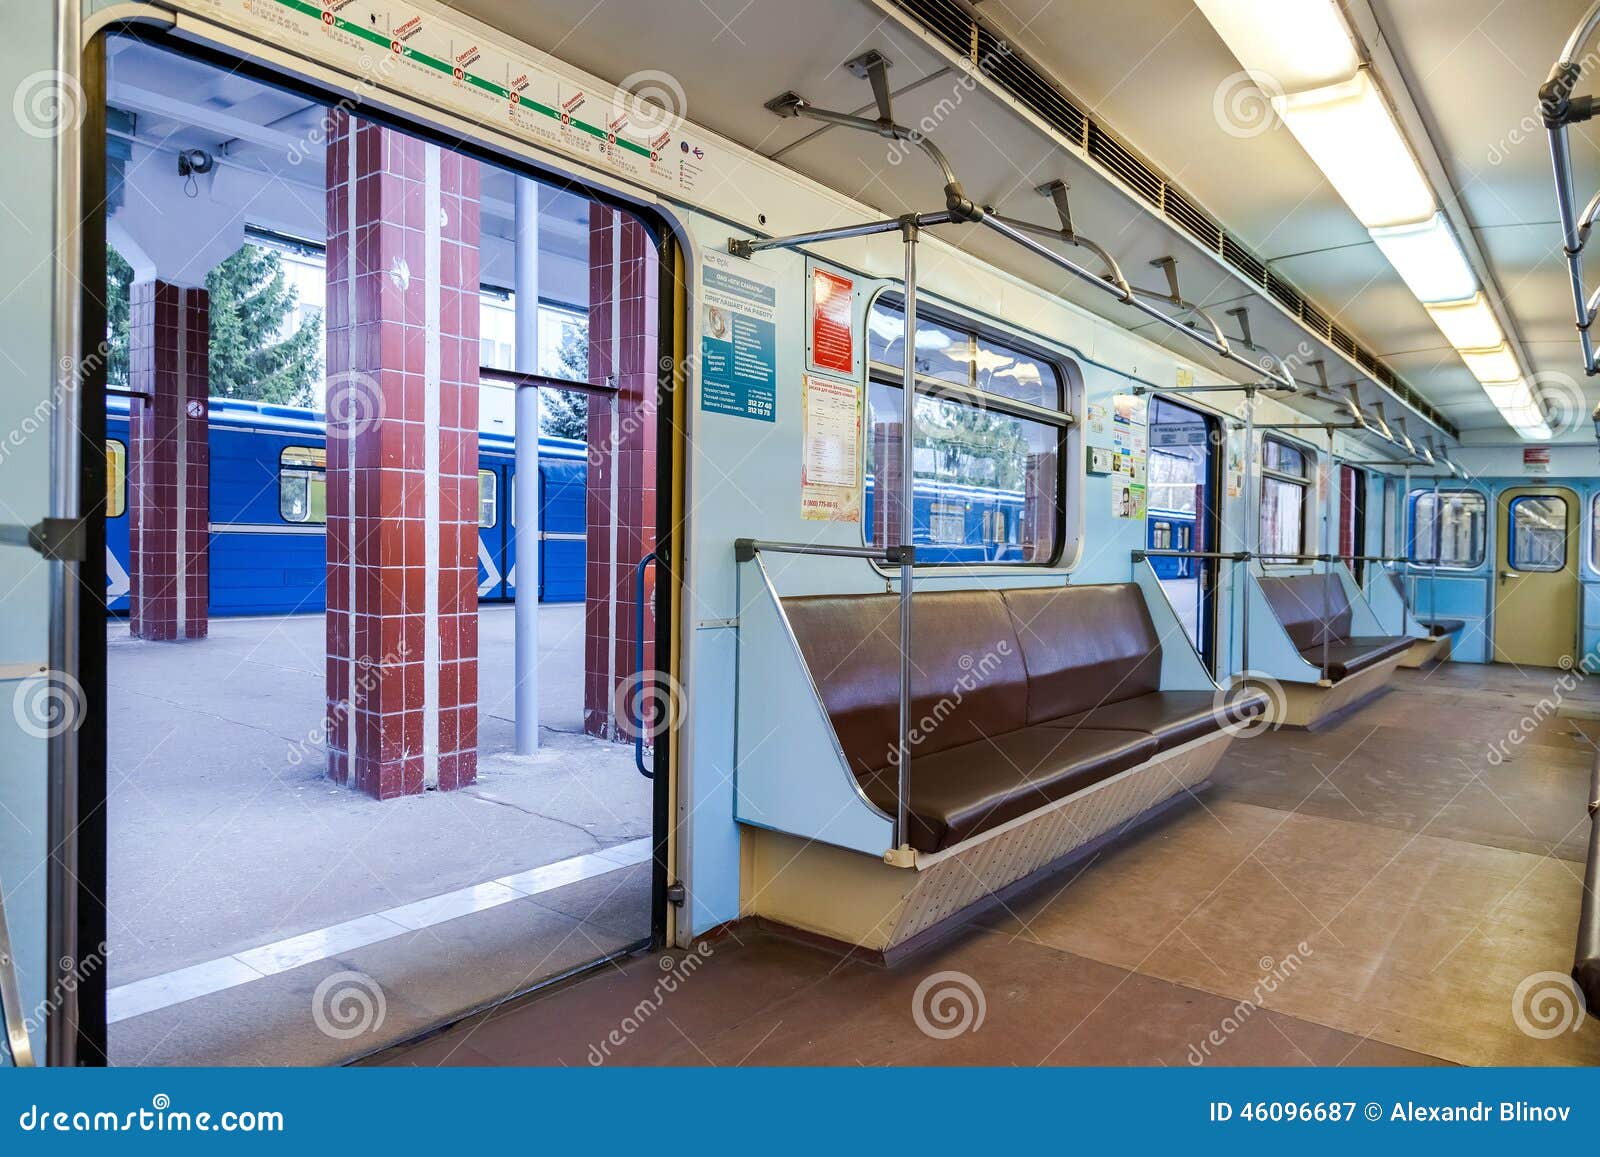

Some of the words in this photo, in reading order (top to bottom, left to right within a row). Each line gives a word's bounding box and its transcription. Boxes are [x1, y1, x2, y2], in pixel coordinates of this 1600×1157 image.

[392, 15, 421, 36] Спортивная
[455, 46, 478, 63] Советская
[704, 294, 744, 310] ПРИГЛАШАЕТ
[752, 308, 774, 319] РАБОТУ
